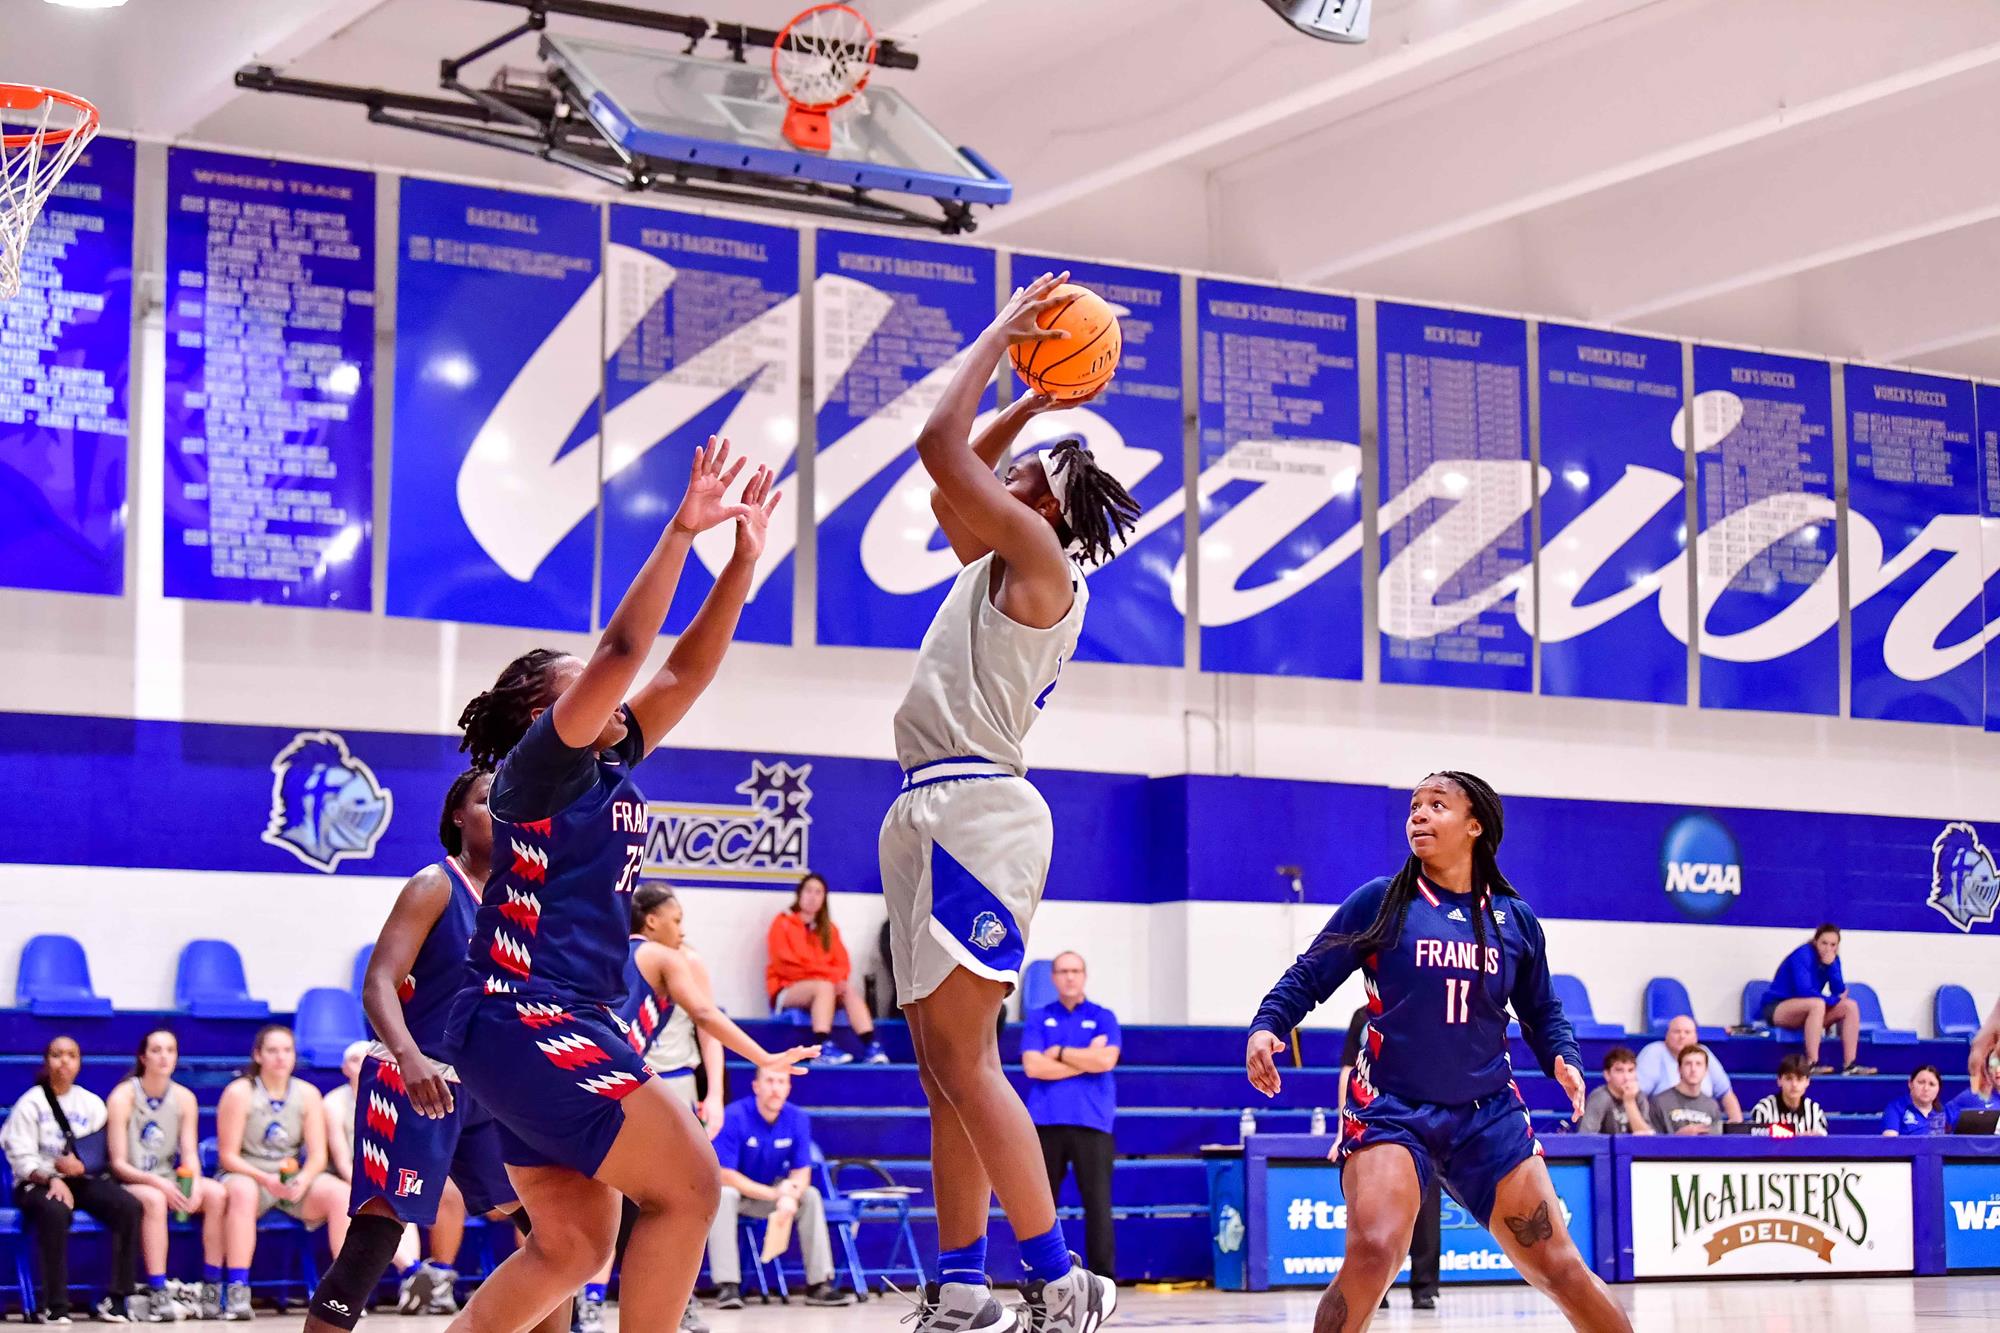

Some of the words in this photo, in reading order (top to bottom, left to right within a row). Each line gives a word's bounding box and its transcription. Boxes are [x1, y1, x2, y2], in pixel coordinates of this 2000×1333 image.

[466, 207, 540, 235] BASEBALL
[682, 233, 769, 263] BASKETBALL
[893, 257, 977, 285] BASKETBALL
[1456, 329, 1482, 348] GOLF
[1622, 351, 1648, 370] GOLF
[1760, 370, 1796, 389] SOCCER
[1874, 385, 1913, 403] WOMEN'S
[1914, 389, 1947, 408] SOCCER
[646, 817, 810, 867] NCCAA
[1665, 861, 1741, 895] NCAA
[1446, 978, 1470, 1023] 11
[1739, 1222, 1798, 1244] DELI
